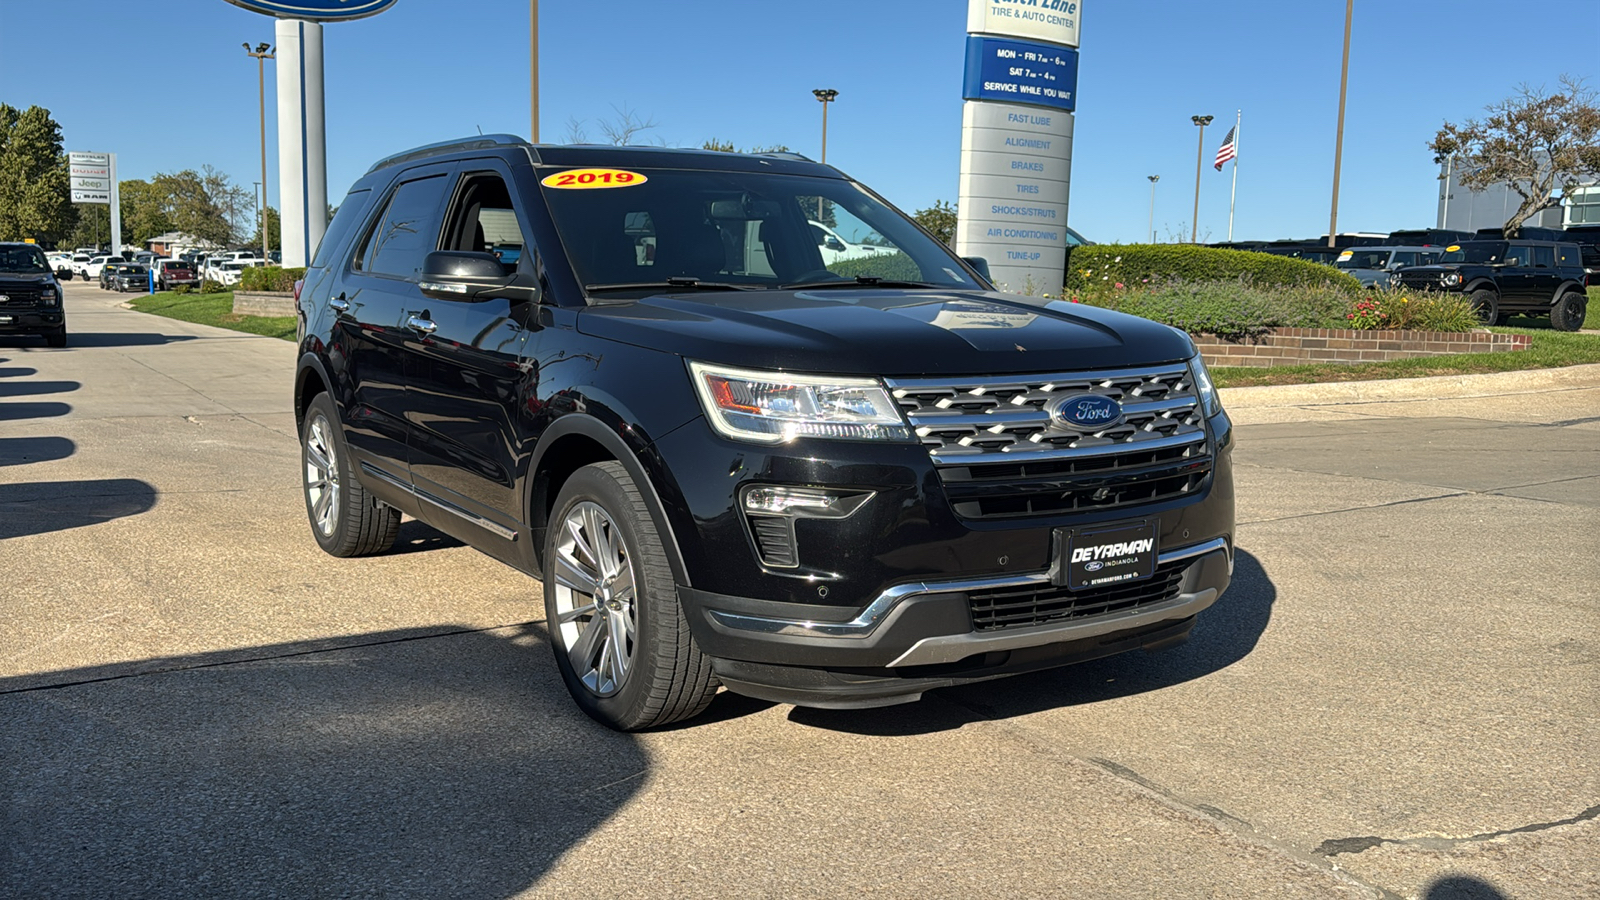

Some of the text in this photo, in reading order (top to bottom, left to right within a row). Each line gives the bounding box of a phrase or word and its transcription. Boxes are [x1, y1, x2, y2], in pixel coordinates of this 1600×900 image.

[992, 7, 1074, 29] TIRE & AUTO CENTER
[997, 49, 1016, 59] MON
[1024, 52, 1036, 61] FRI
[1009, 67, 1023, 76] SAT
[984, 81, 1071, 100] SERVICE WHILE YOU WAIT
[1008, 113, 1051, 126] FAST LUBE
[1005, 137, 1051, 150] ALIGNMENT
[1011, 161, 1044, 172] BRAKES
[78, 179, 102, 188] Jeep
[556, 172, 635, 186] 2019
[1016, 184, 1039, 194] TIRES
[991, 205, 1056, 219] SHOCKS/STRUTS
[987, 228, 1058, 240] AIR CONDITIONING
[1007, 251, 1041, 260] TUNE-UP
[1076, 401, 1112, 420] Ford
[1071, 538, 1153, 563] DEYARMAN
[1105, 557, 1139, 567] INDIANOLA
